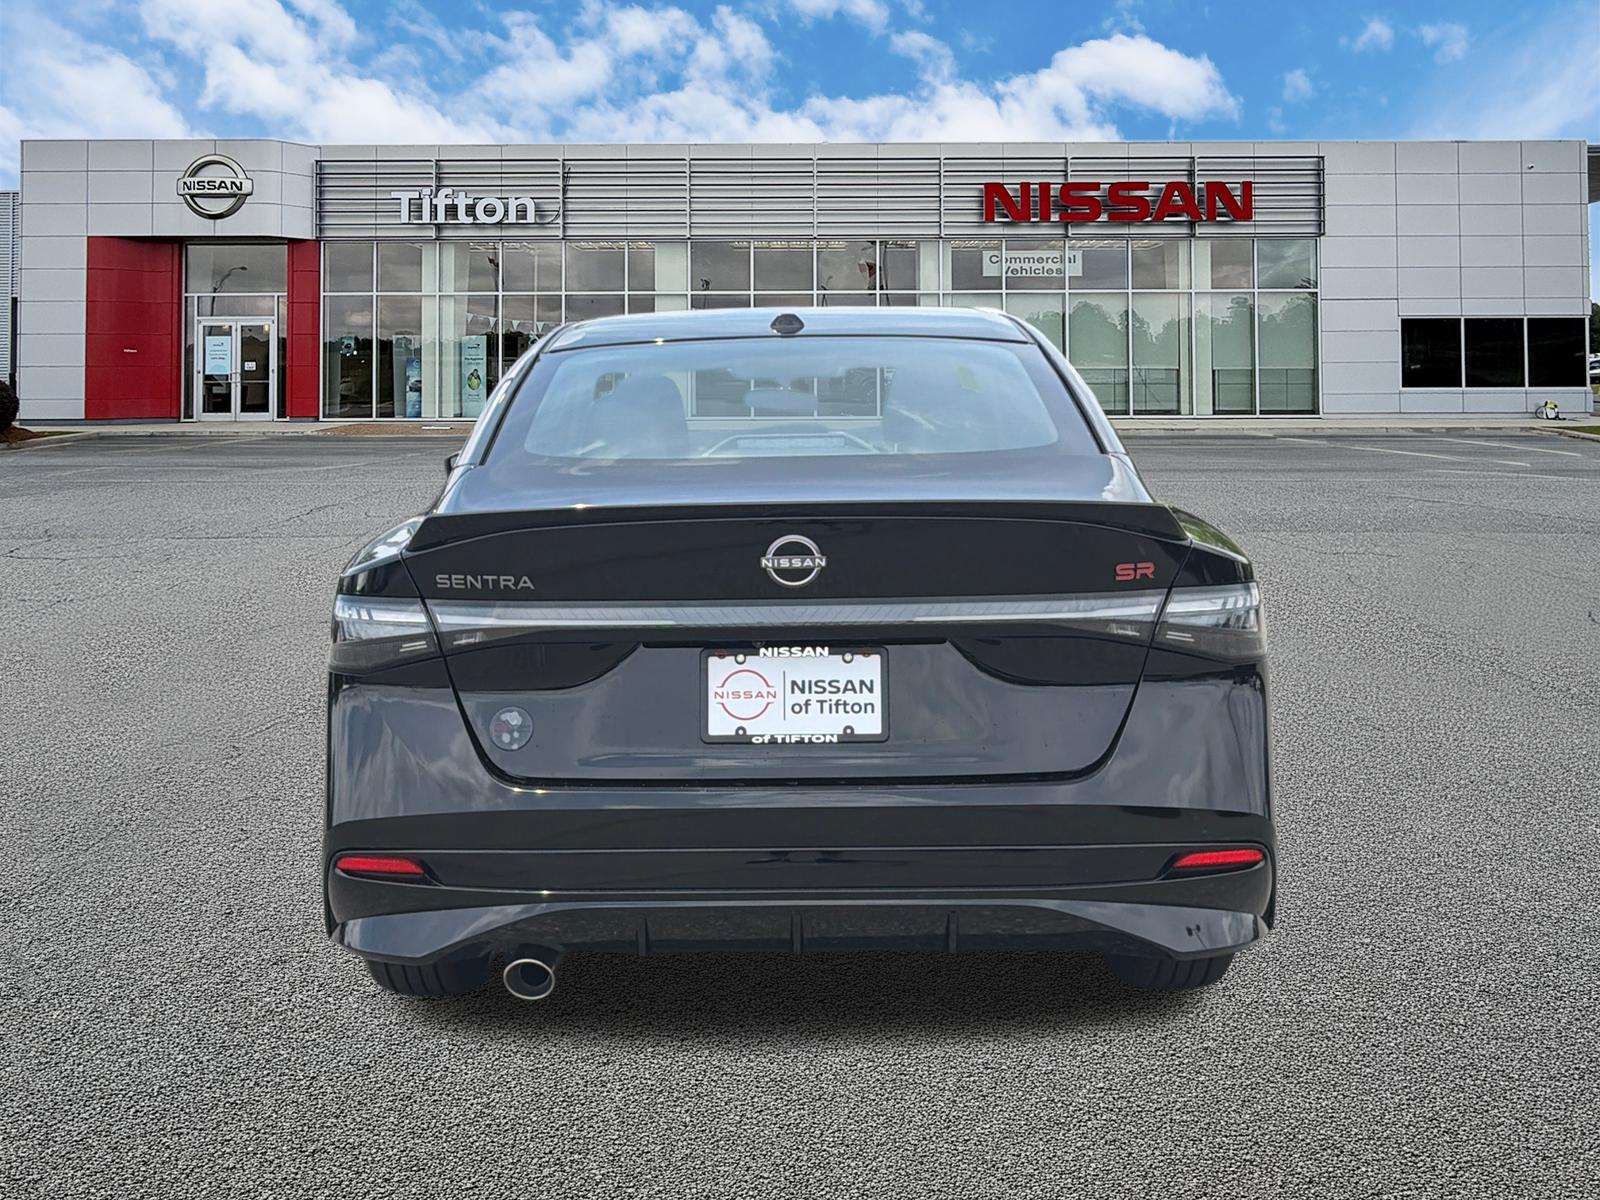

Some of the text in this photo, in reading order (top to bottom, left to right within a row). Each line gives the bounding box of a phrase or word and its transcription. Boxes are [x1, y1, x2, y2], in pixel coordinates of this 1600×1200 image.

[183, 181, 243, 191] NISSAN
[391, 188, 536, 223] Tifton
[984, 181, 1253, 221] NISSAN
[761, 558, 826, 568] NISSAN
[1115, 562, 1155, 580] SR
[435, 574, 535, 590] SENTRA
[759, 646, 829, 658] NISSAN
[714, 690, 777, 700] NISSAN
[790, 679, 874, 695] NISSAN
[791, 698, 875, 714] of Tifton
[751, 735, 838, 743] of TIFTON
